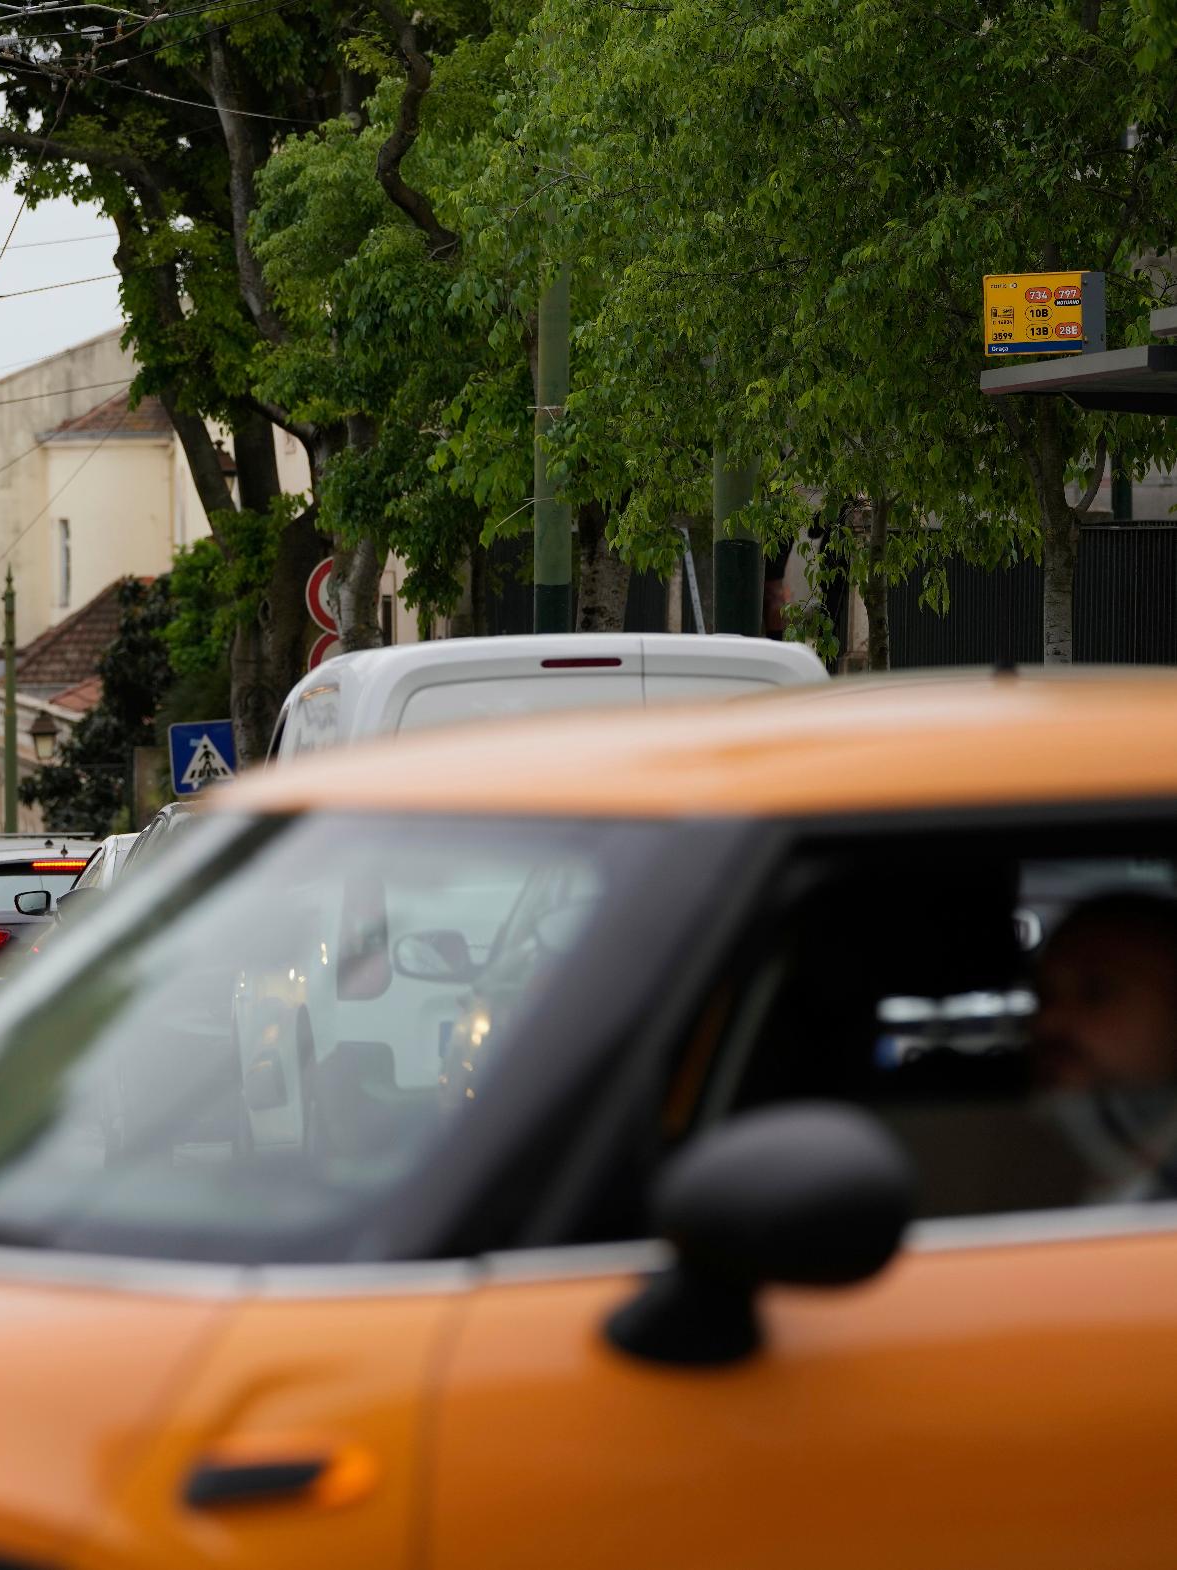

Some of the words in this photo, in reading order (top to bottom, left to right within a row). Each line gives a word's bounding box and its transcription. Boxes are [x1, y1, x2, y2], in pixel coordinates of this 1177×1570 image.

[1029, 291, 1048, 299] 734
[1058, 290, 1077, 299] 797
[1030, 309, 1048, 317] 10B
[1030, 327, 1049, 336] 13B
[1060, 326, 1078, 335] 28E
